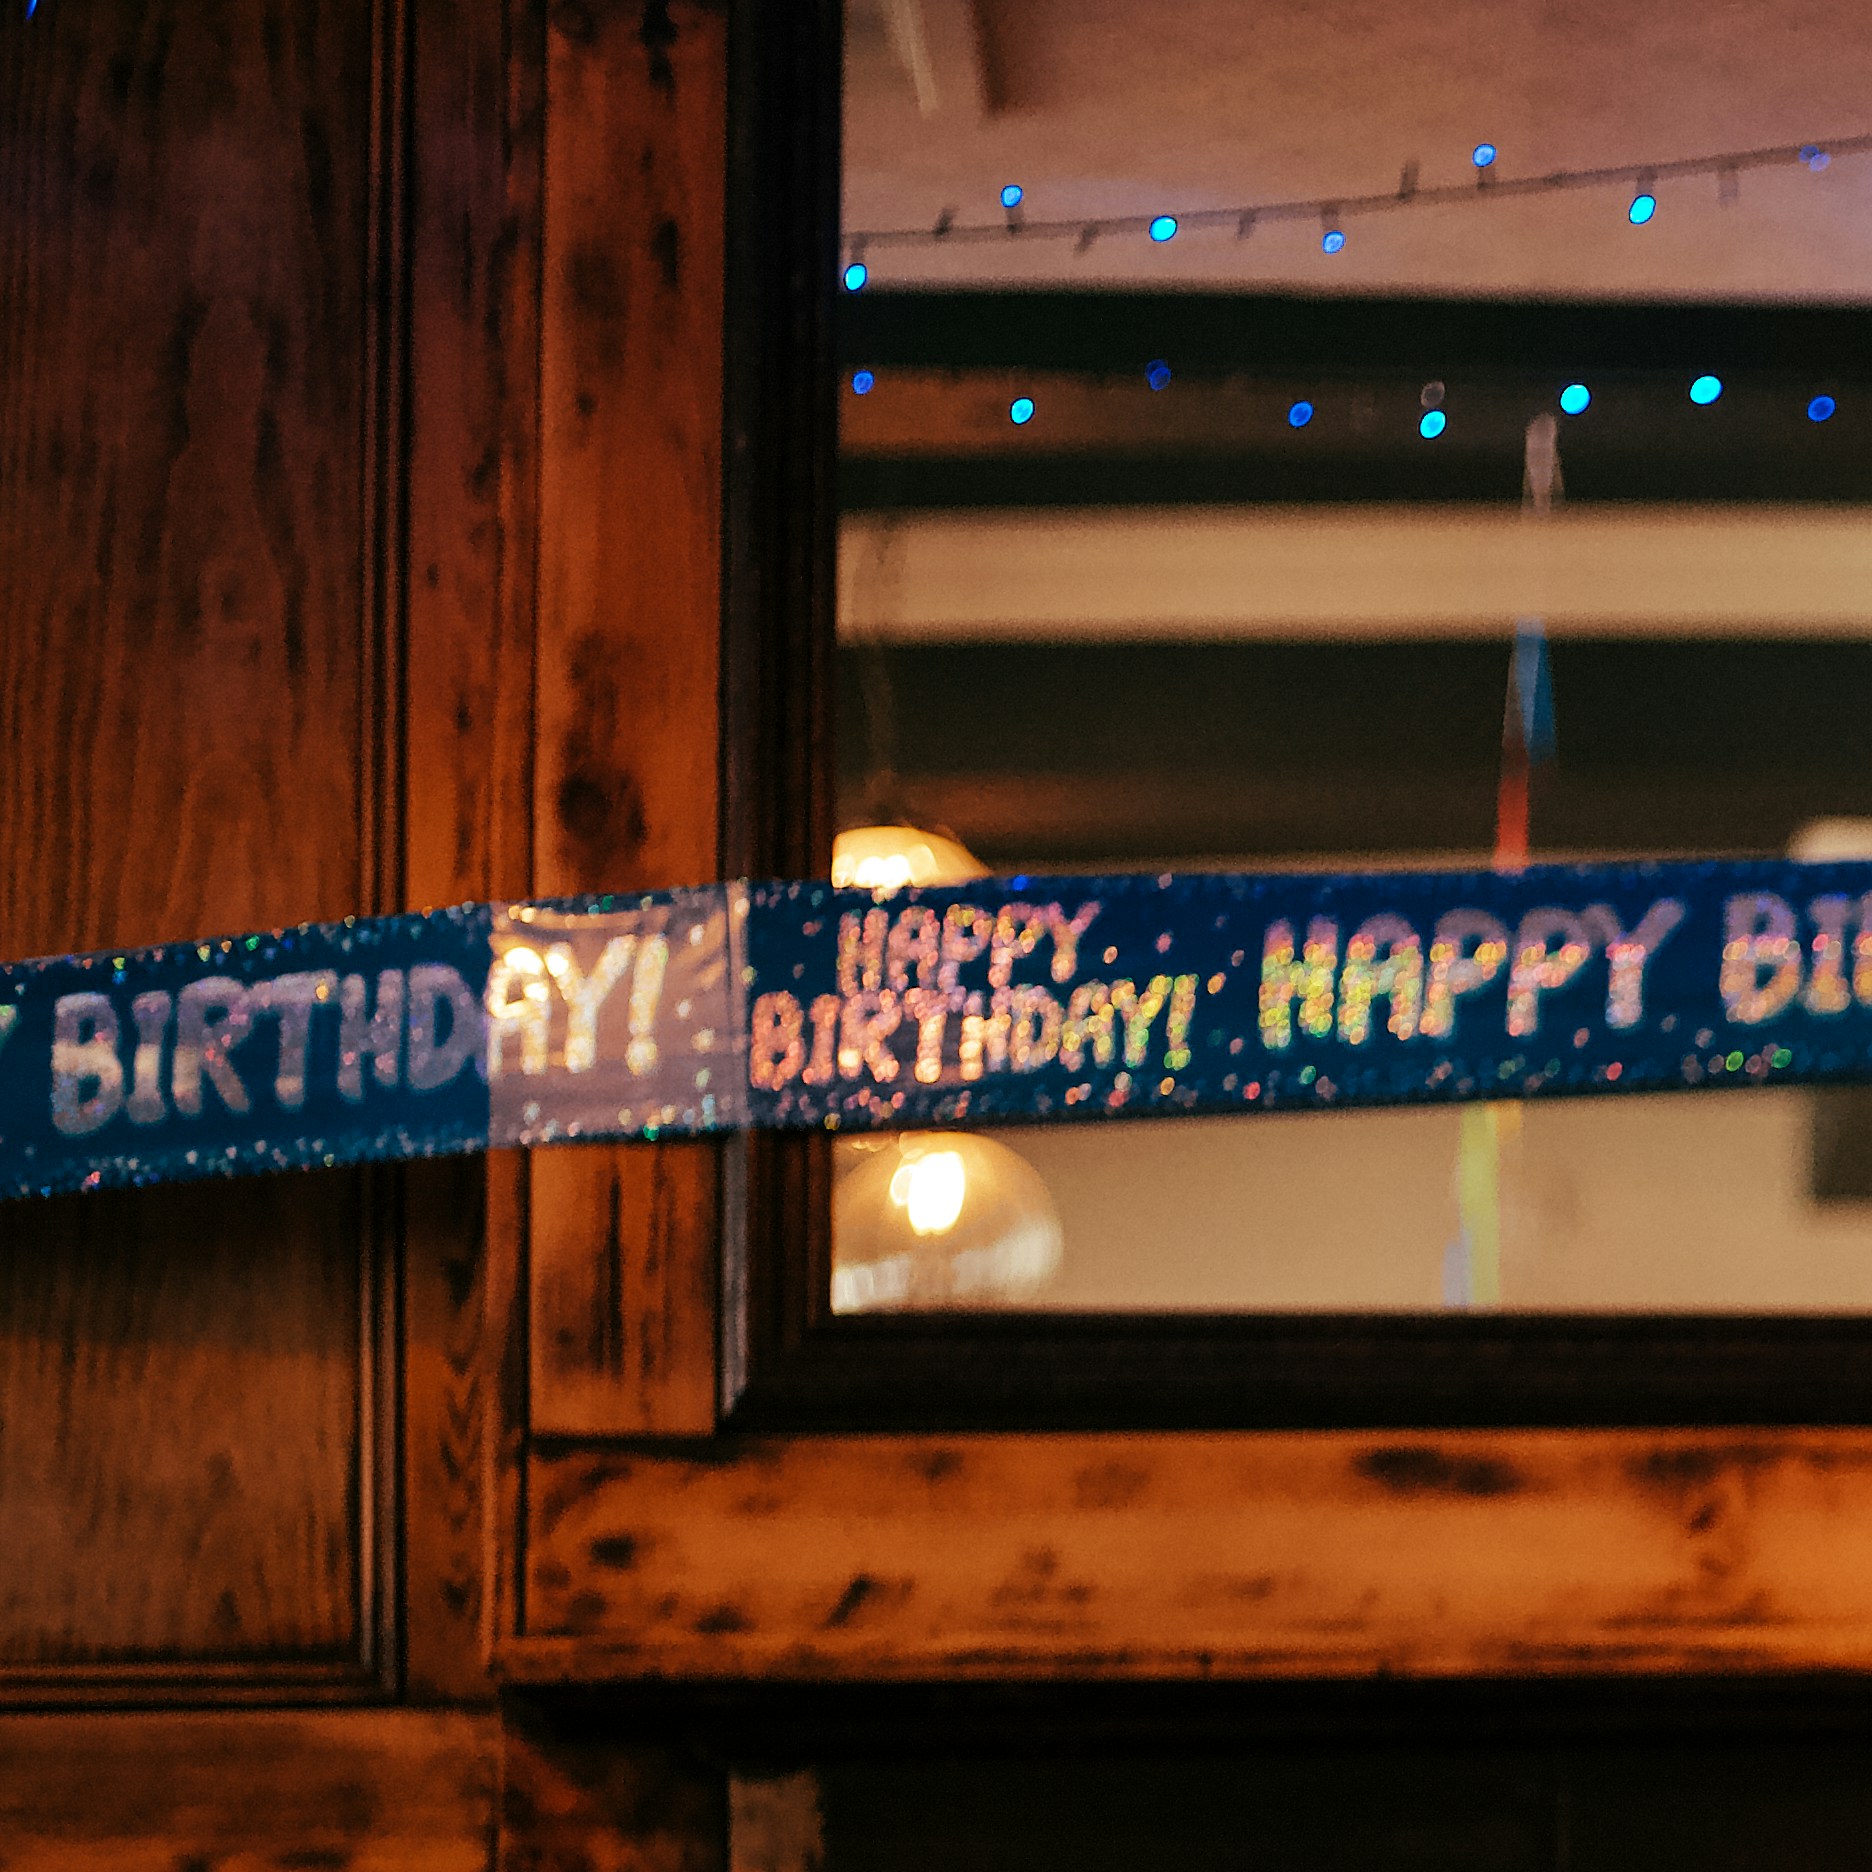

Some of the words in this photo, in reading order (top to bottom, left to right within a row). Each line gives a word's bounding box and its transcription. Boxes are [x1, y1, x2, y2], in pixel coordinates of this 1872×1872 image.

[835, 900, 1102, 994] HAPPY
[1260, 898, 1686, 1048] HAPPY
[48, 934, 672, 1136] BIRTHDAY!
[748, 974, 1200, 1088] BIRTHDAY!
